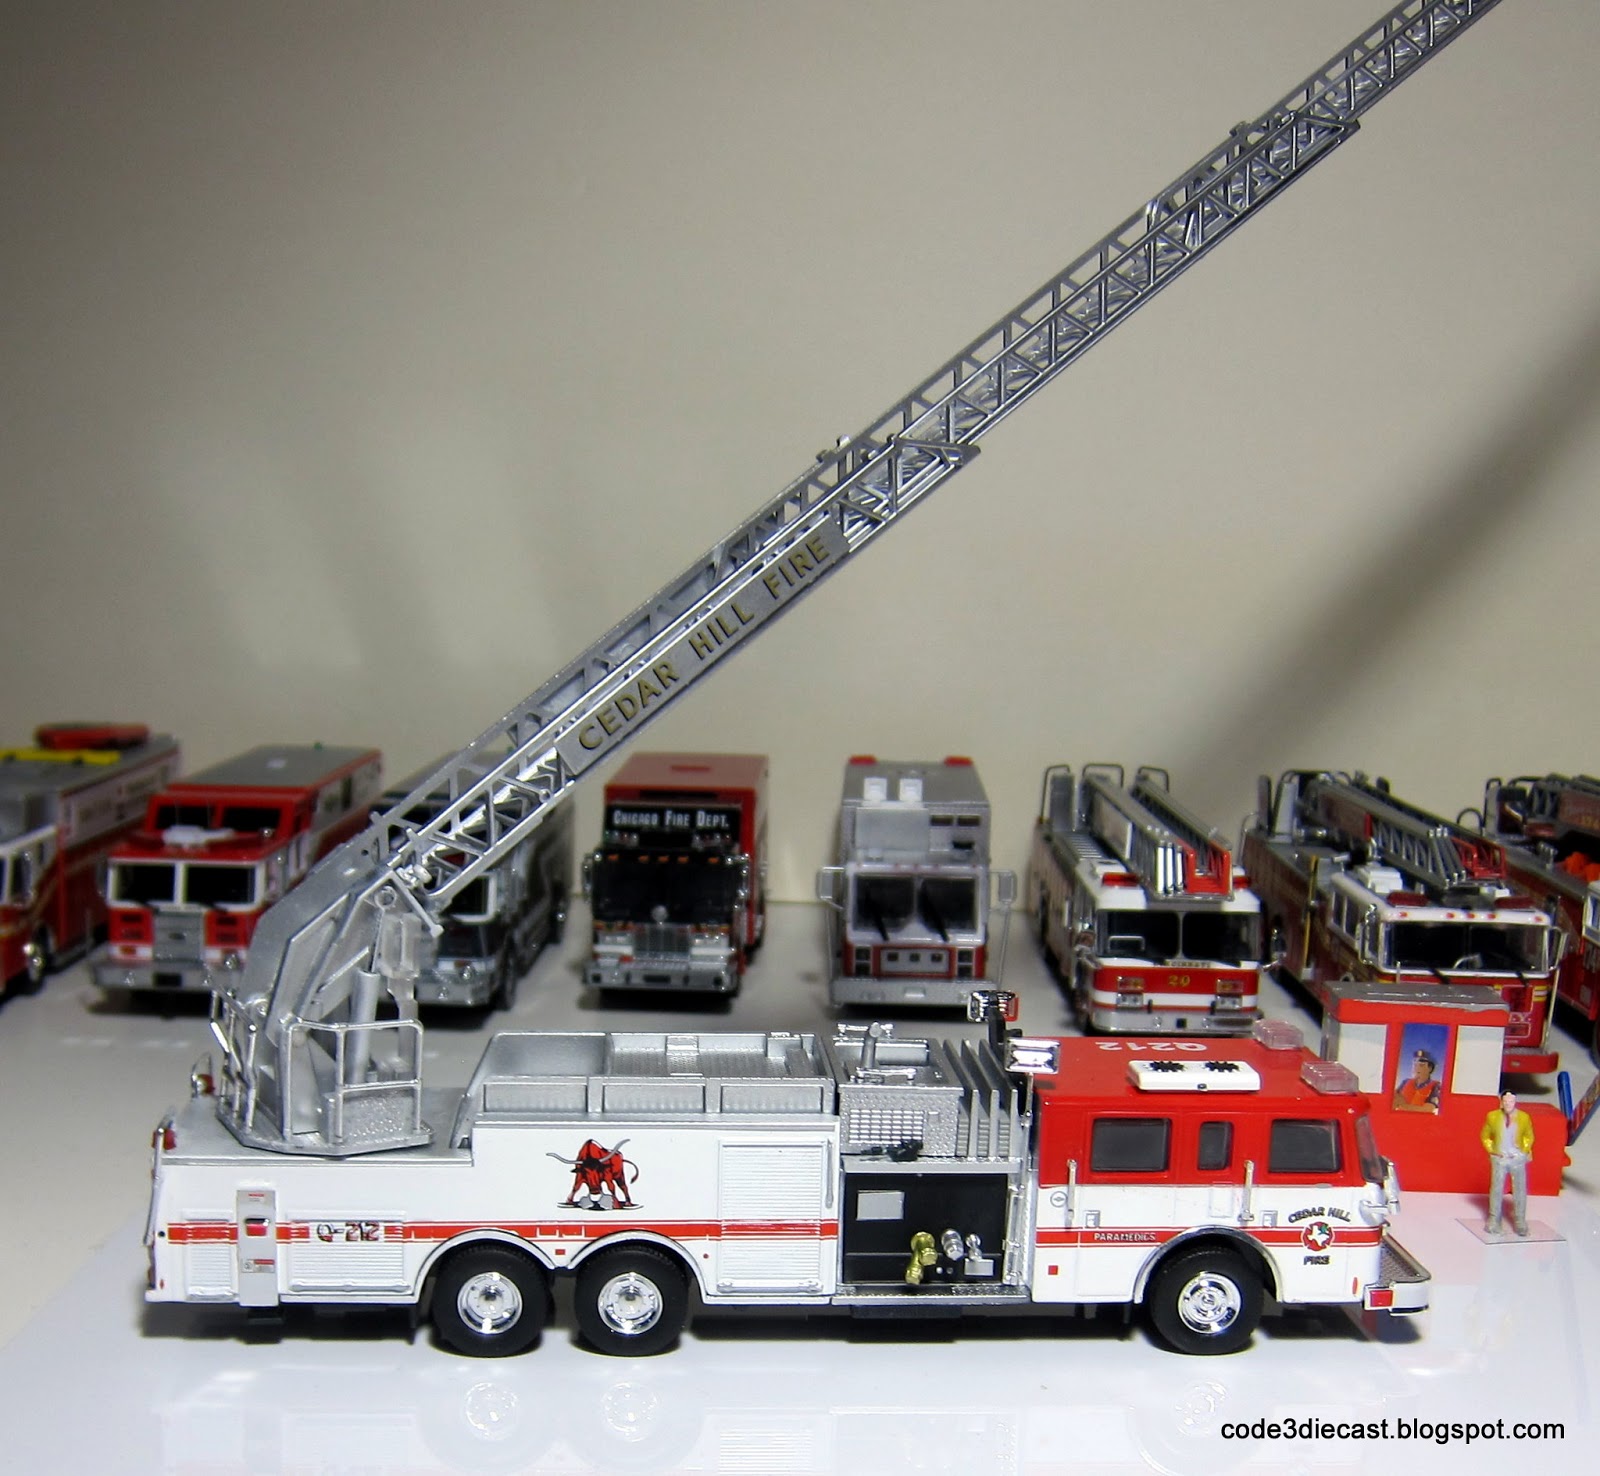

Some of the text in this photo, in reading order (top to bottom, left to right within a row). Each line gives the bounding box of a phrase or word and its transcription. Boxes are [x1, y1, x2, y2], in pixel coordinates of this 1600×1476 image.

[578, 535, 831, 751] CEDAR HILL FIRE
[696, 810, 730, 828] DEPT.
[1095, 1041, 1207, 1052] Q212
[1288, 1206, 1351, 1224] CEDAR HILL
[1094, 1232, 1157, 1242] PARAMEDICS
[1303, 1254, 1331, 1266] FIRE
